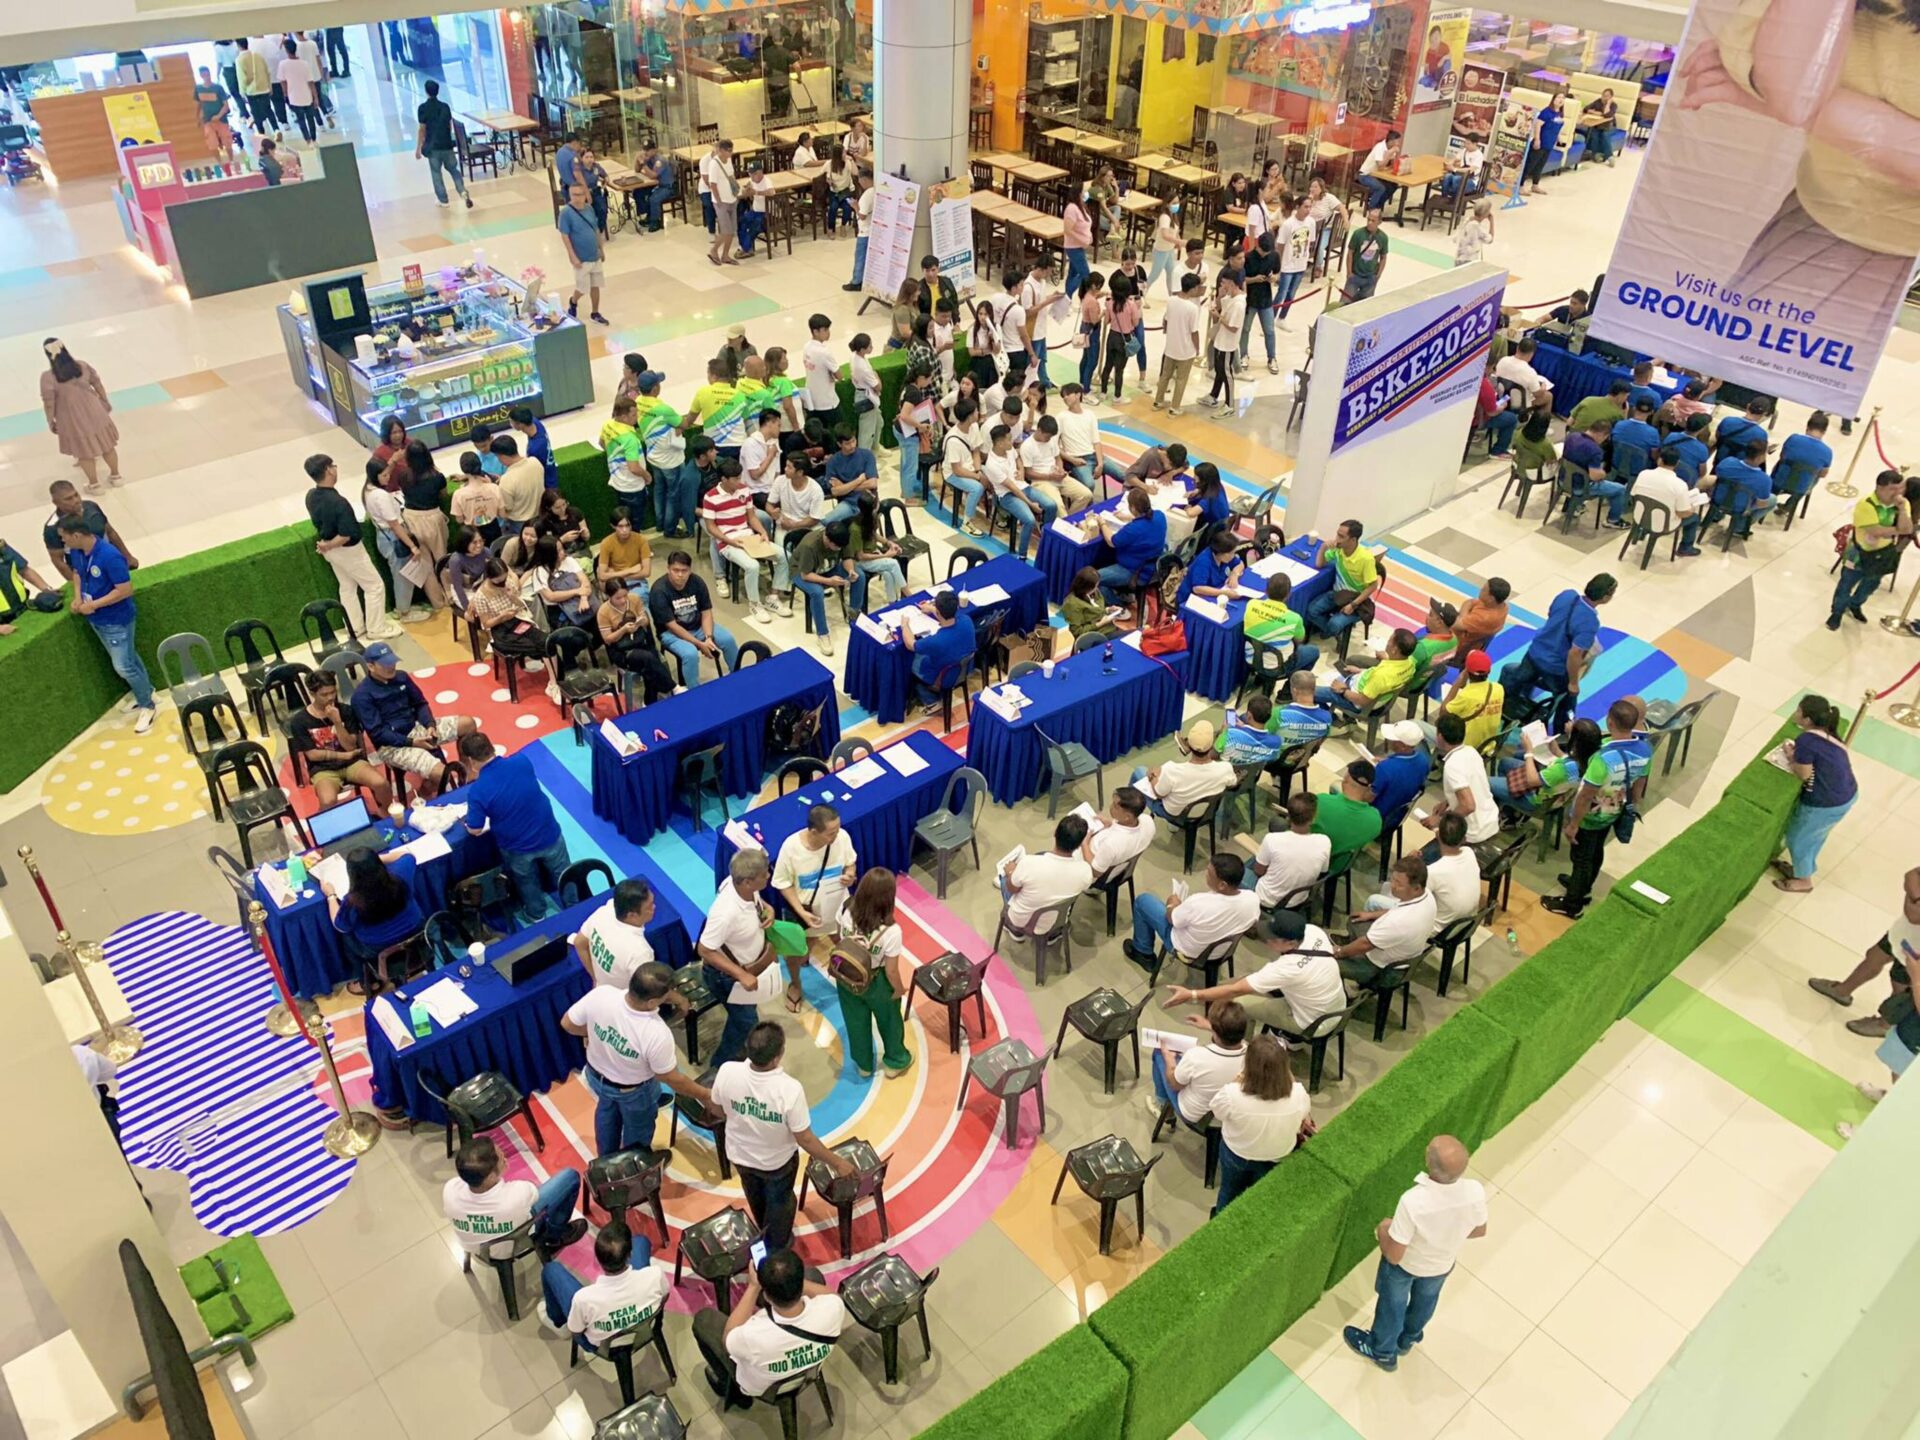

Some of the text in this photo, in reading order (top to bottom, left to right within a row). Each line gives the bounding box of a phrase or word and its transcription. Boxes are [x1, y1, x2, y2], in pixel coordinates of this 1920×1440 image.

[1443, 75, 1456, 85] 15
[1675, 270, 1816, 325] Visit us at the
[1618, 281, 1855, 372] GROUND LEVEL
[1348, 286, 1498, 393] FILING OF CERTIFICATE OF CANDIDACY
[1347, 302, 1495, 429] BSKE2023
[1346, 411, 1378, 438] BARANGAY
[1378, 400, 1393, 416] AND
[591, 927, 615, 965] TEAM
[607, 1034, 639, 1059] MALLARI
[744, 1096, 767, 1110] TEAM
[748, 1103, 783, 1124] MALLARI
[467, 1214, 494, 1223] TEAM
[472, 1221, 514, 1234] MALLARI
[608, 1304, 637, 1320] TEAM
[785, 1343, 813, 1358] TEAM
[791, 1343, 831, 1370] MALLARI
